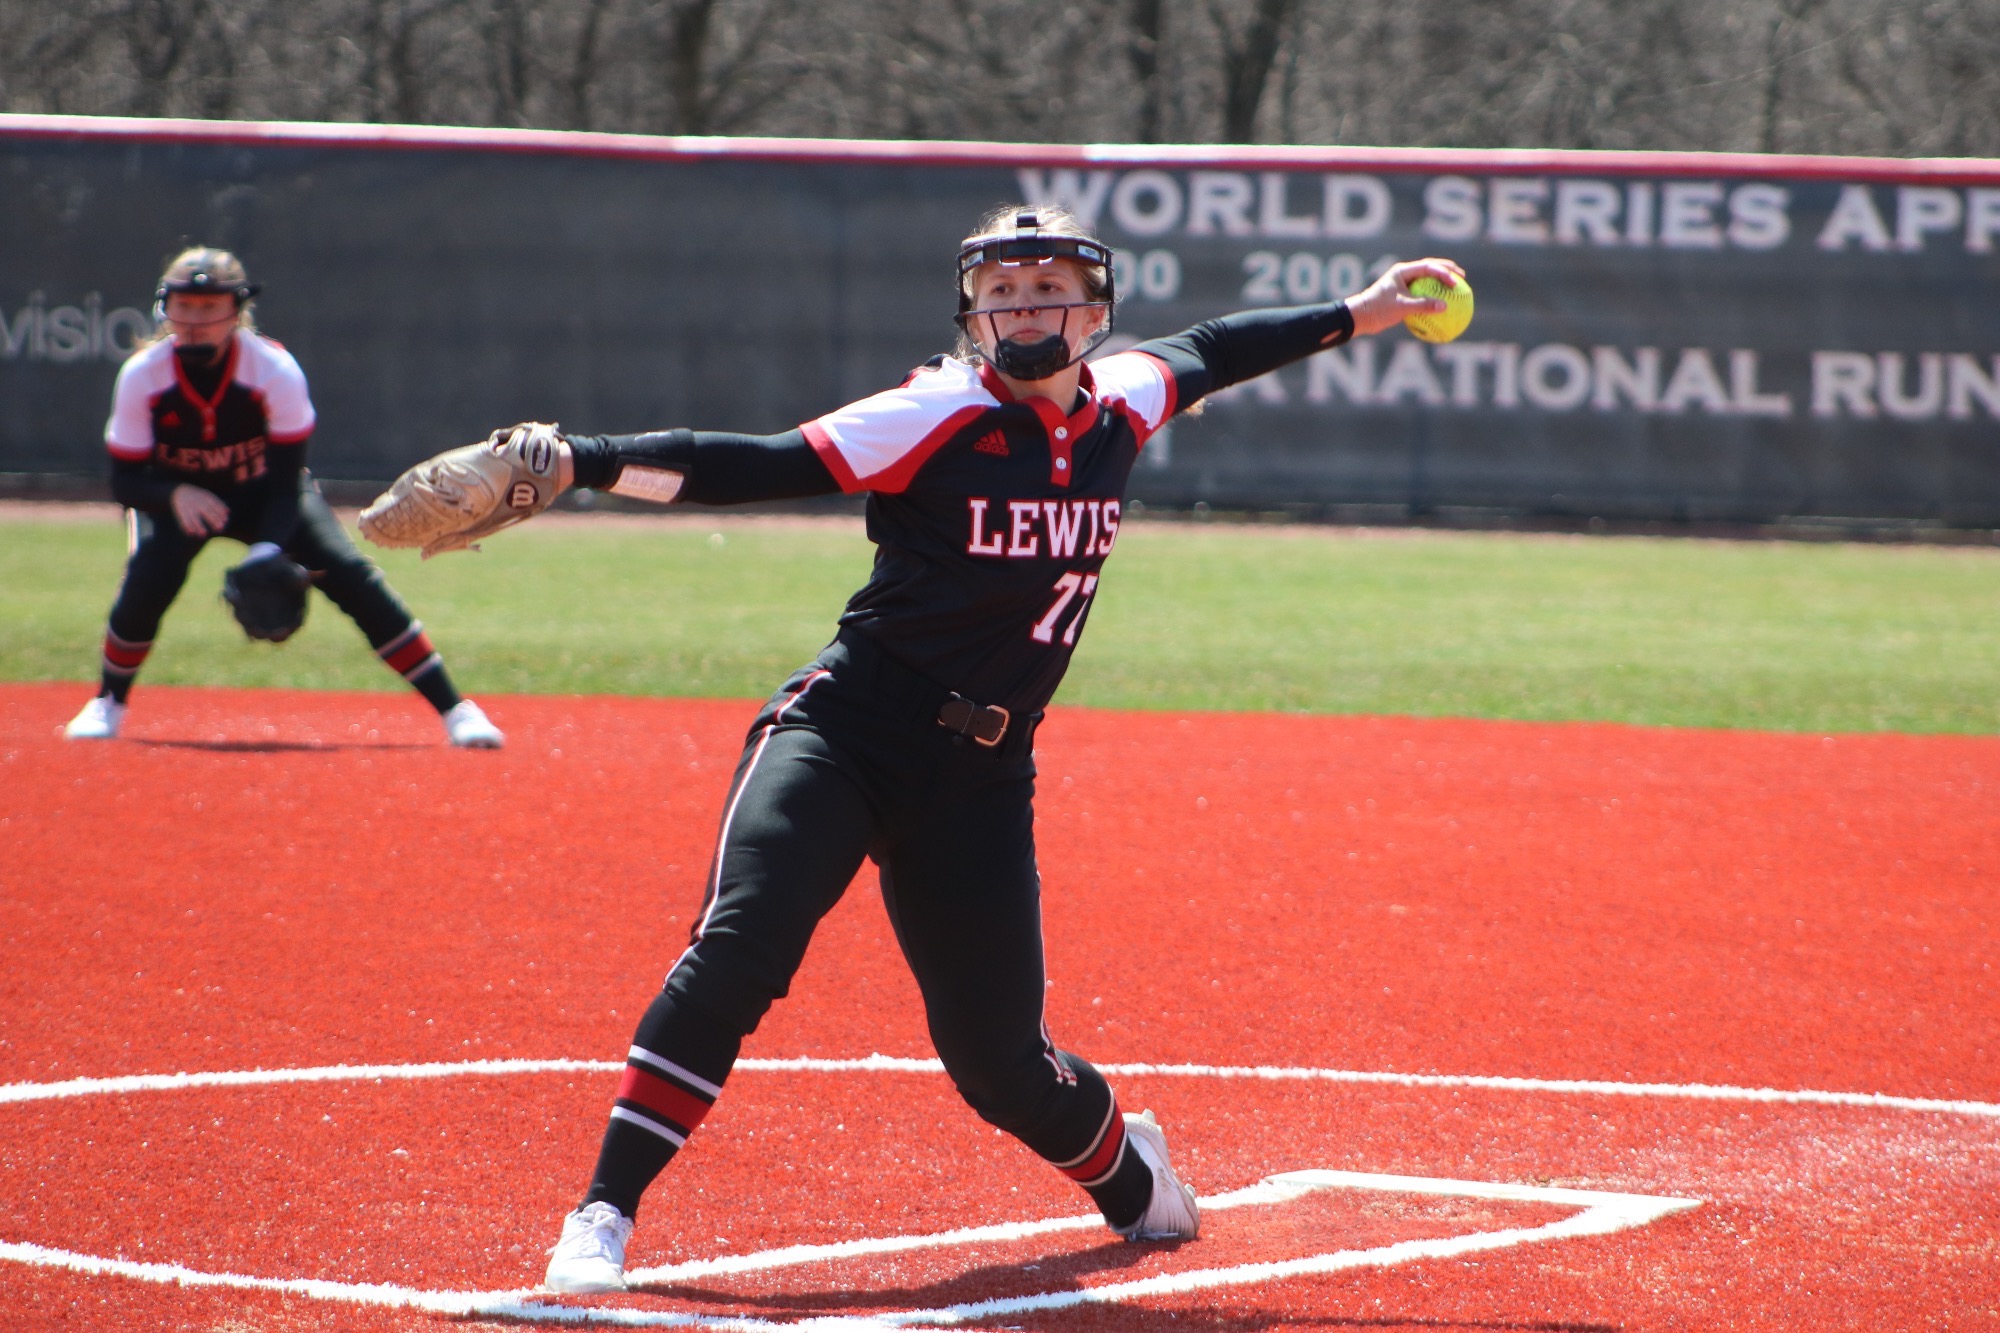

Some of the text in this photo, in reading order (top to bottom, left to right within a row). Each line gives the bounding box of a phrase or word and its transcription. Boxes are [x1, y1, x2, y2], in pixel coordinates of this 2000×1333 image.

[1017, 168, 1392, 240] WORLD
[1422, 175, 1791, 250] SERIES
[0, 289, 156, 361] visio
[1307, 340, 1791, 414] NATIONAL
[1810, 351, 2000, 417] RUN
[158, 437, 265, 470] LEWIS
[974, 440, 1010, 457] adidas
[967, 497, 1121, 558] LEWIS
[1030, 569, 1099, 646] 77
